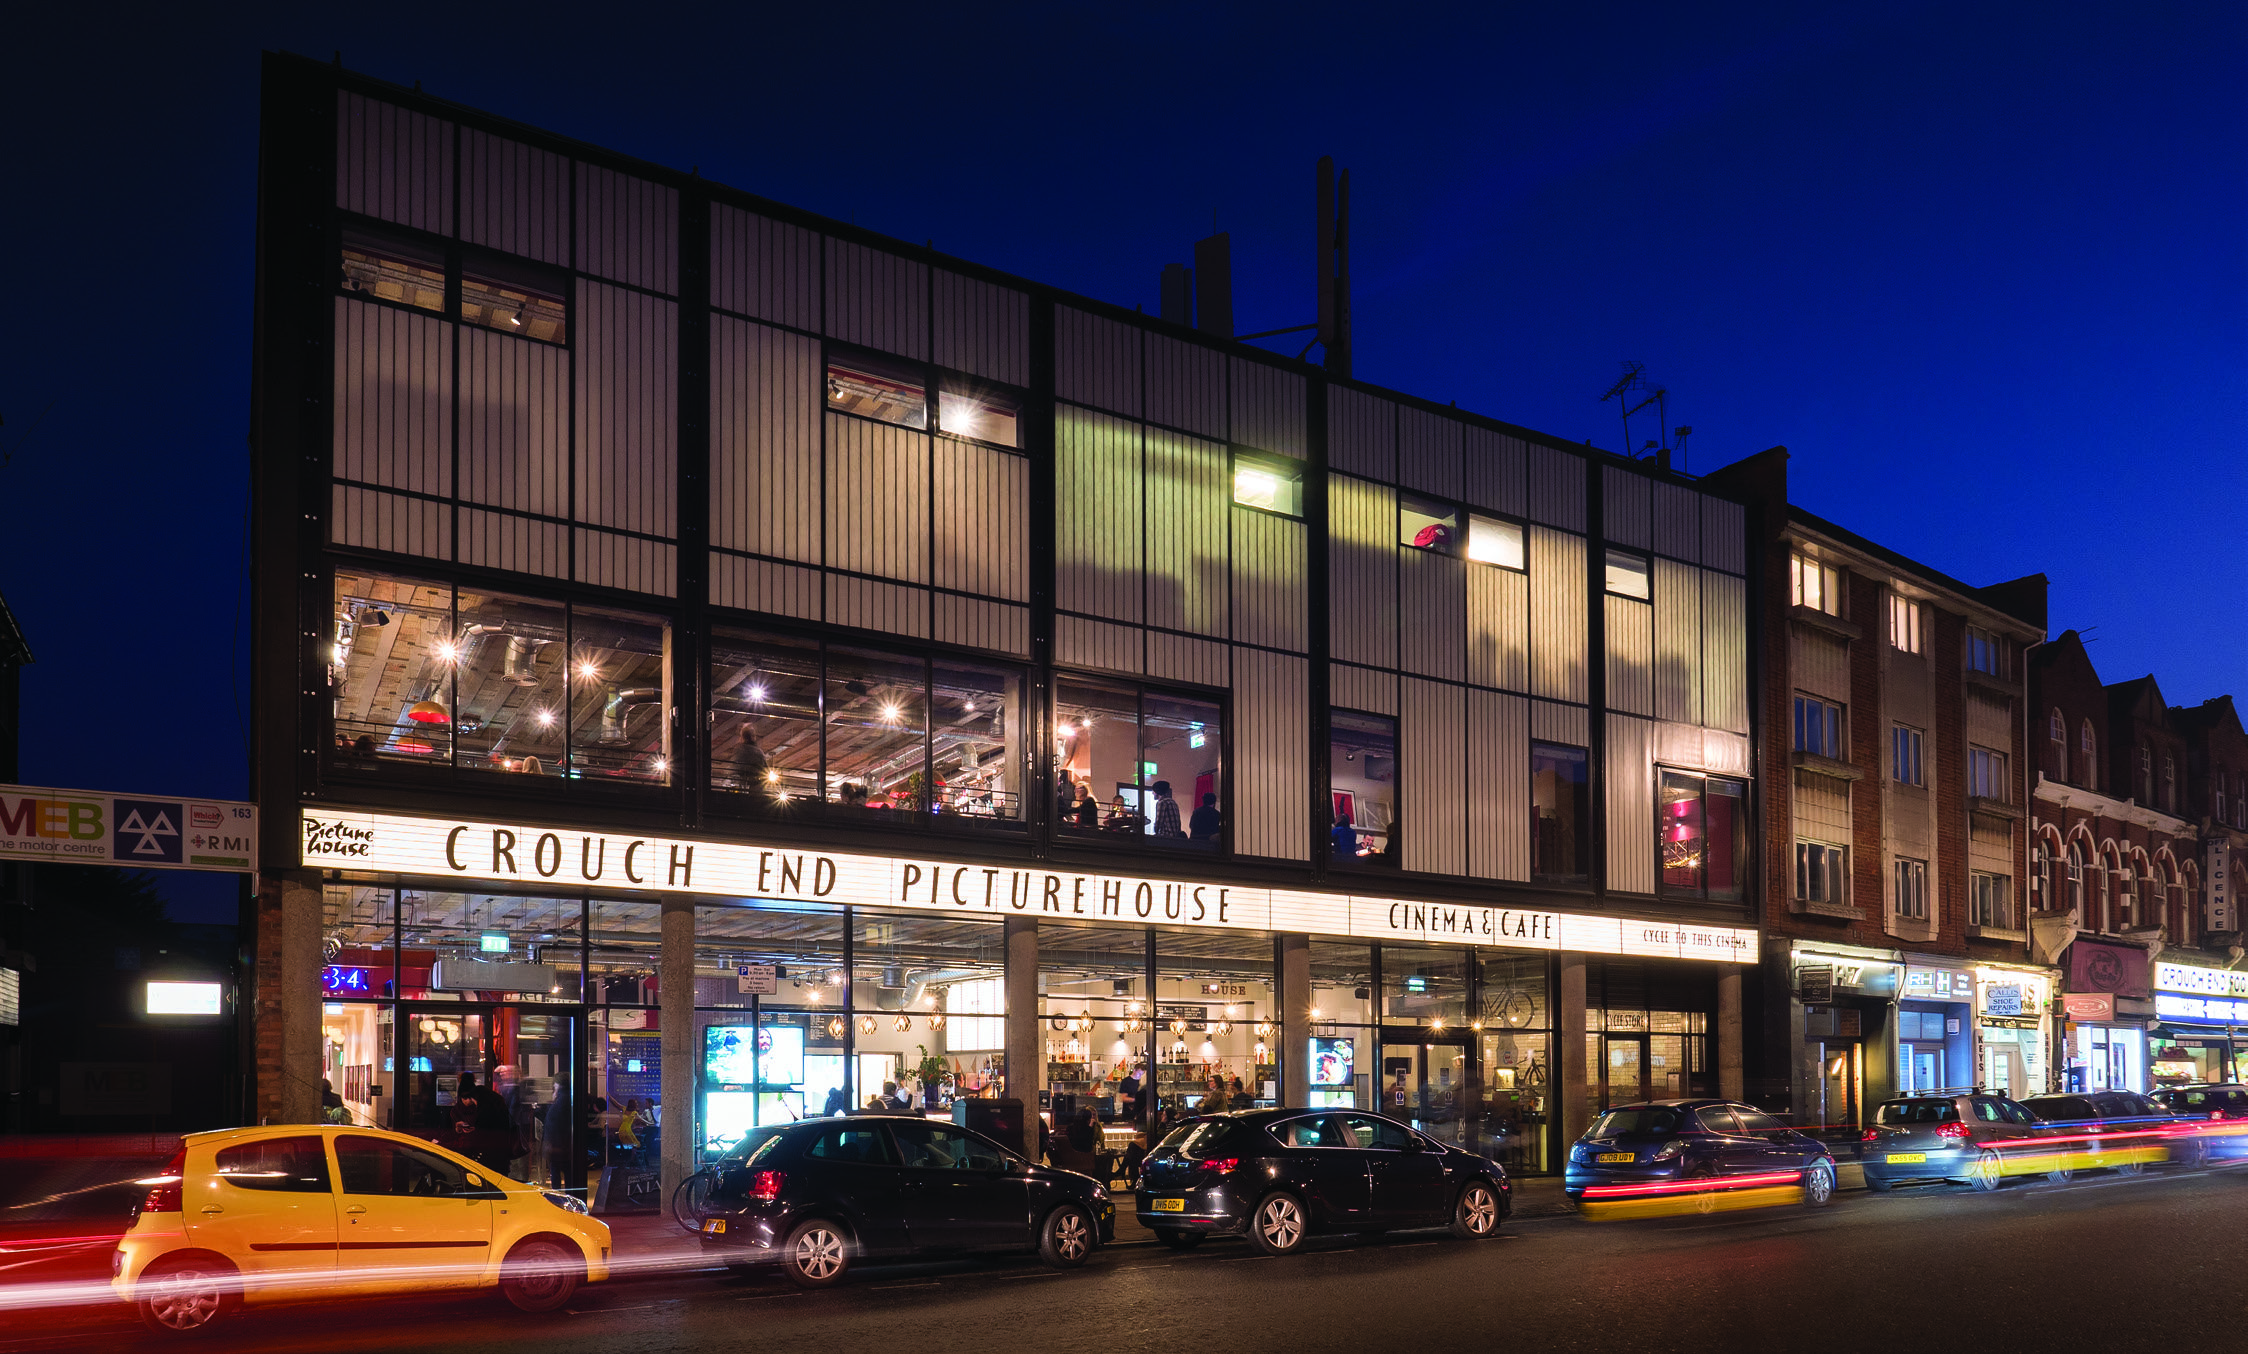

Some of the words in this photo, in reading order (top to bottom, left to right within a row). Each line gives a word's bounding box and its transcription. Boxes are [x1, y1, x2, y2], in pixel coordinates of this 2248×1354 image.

[0, 796, 105, 840] MEB
[232, 808, 251, 819] 163
[303, 817, 373, 842] Picture
[20, 841, 60, 852] motor
[63, 843, 105, 854] centre
[208, 835, 249, 852] RMI
[307, 833, 369, 857] house
[445, 825, 694, 888] CROUCH
[757, 850, 837, 898] END
[902, 863, 1230, 923] PICTUREHOUSE
[2214, 847, 2225, 929] LICENCE
[1389, 903, 1474, 934] CINEMA
[1501, 911, 1552, 940] CAFE
[1643, 929, 1669, 944] CYCLE
[1675, 931, 1687, 945] TO
[1692, 933, 1712, 947] THIS
[1716, 935, 1747, 949] CINEMA
[2162, 968, 2204, 988] CROUCH
[1201, 984, 1246, 996] HOUSE
[1625, 1014, 1644, 1028] STORE
